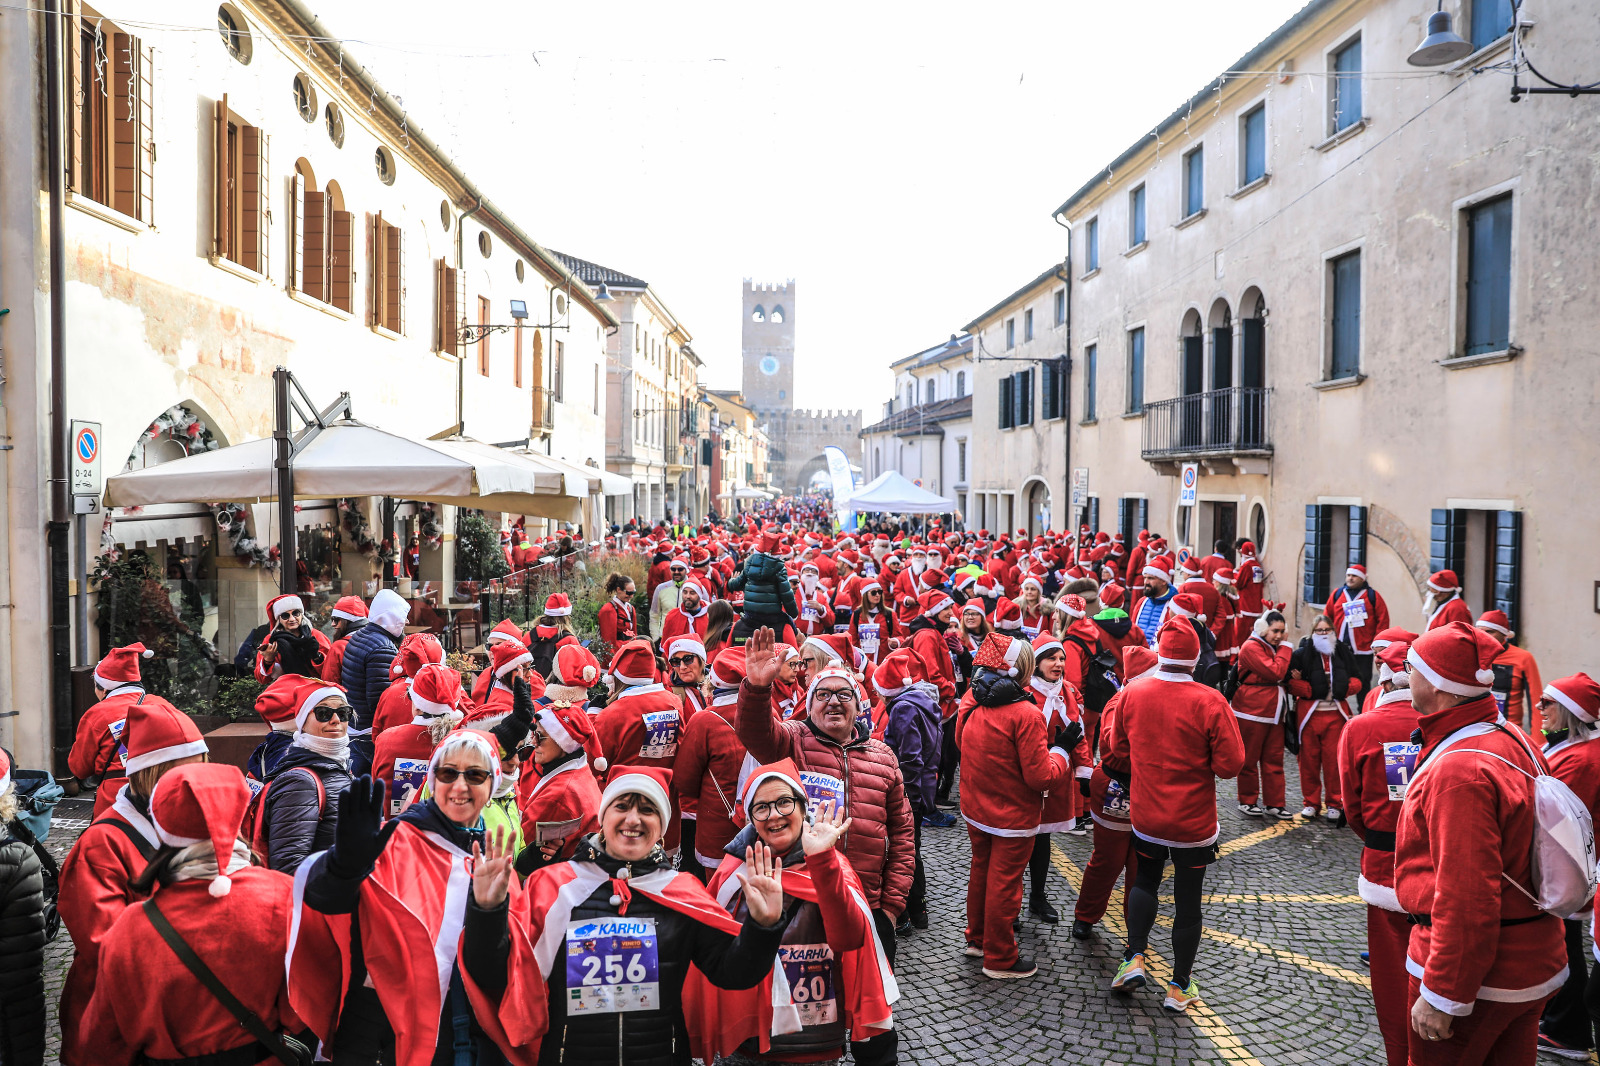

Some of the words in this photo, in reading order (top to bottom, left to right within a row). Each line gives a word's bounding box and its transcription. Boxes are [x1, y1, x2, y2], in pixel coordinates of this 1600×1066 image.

[862, 632, 877, 640] 102
[650, 730, 675, 746] 645
[807, 775, 840, 789] KARHU
[598, 923, 648, 936] KARHU
[788, 948, 830, 960] KARHU
[581, 953, 647, 986] 256
[788, 975, 826, 1003] 60
